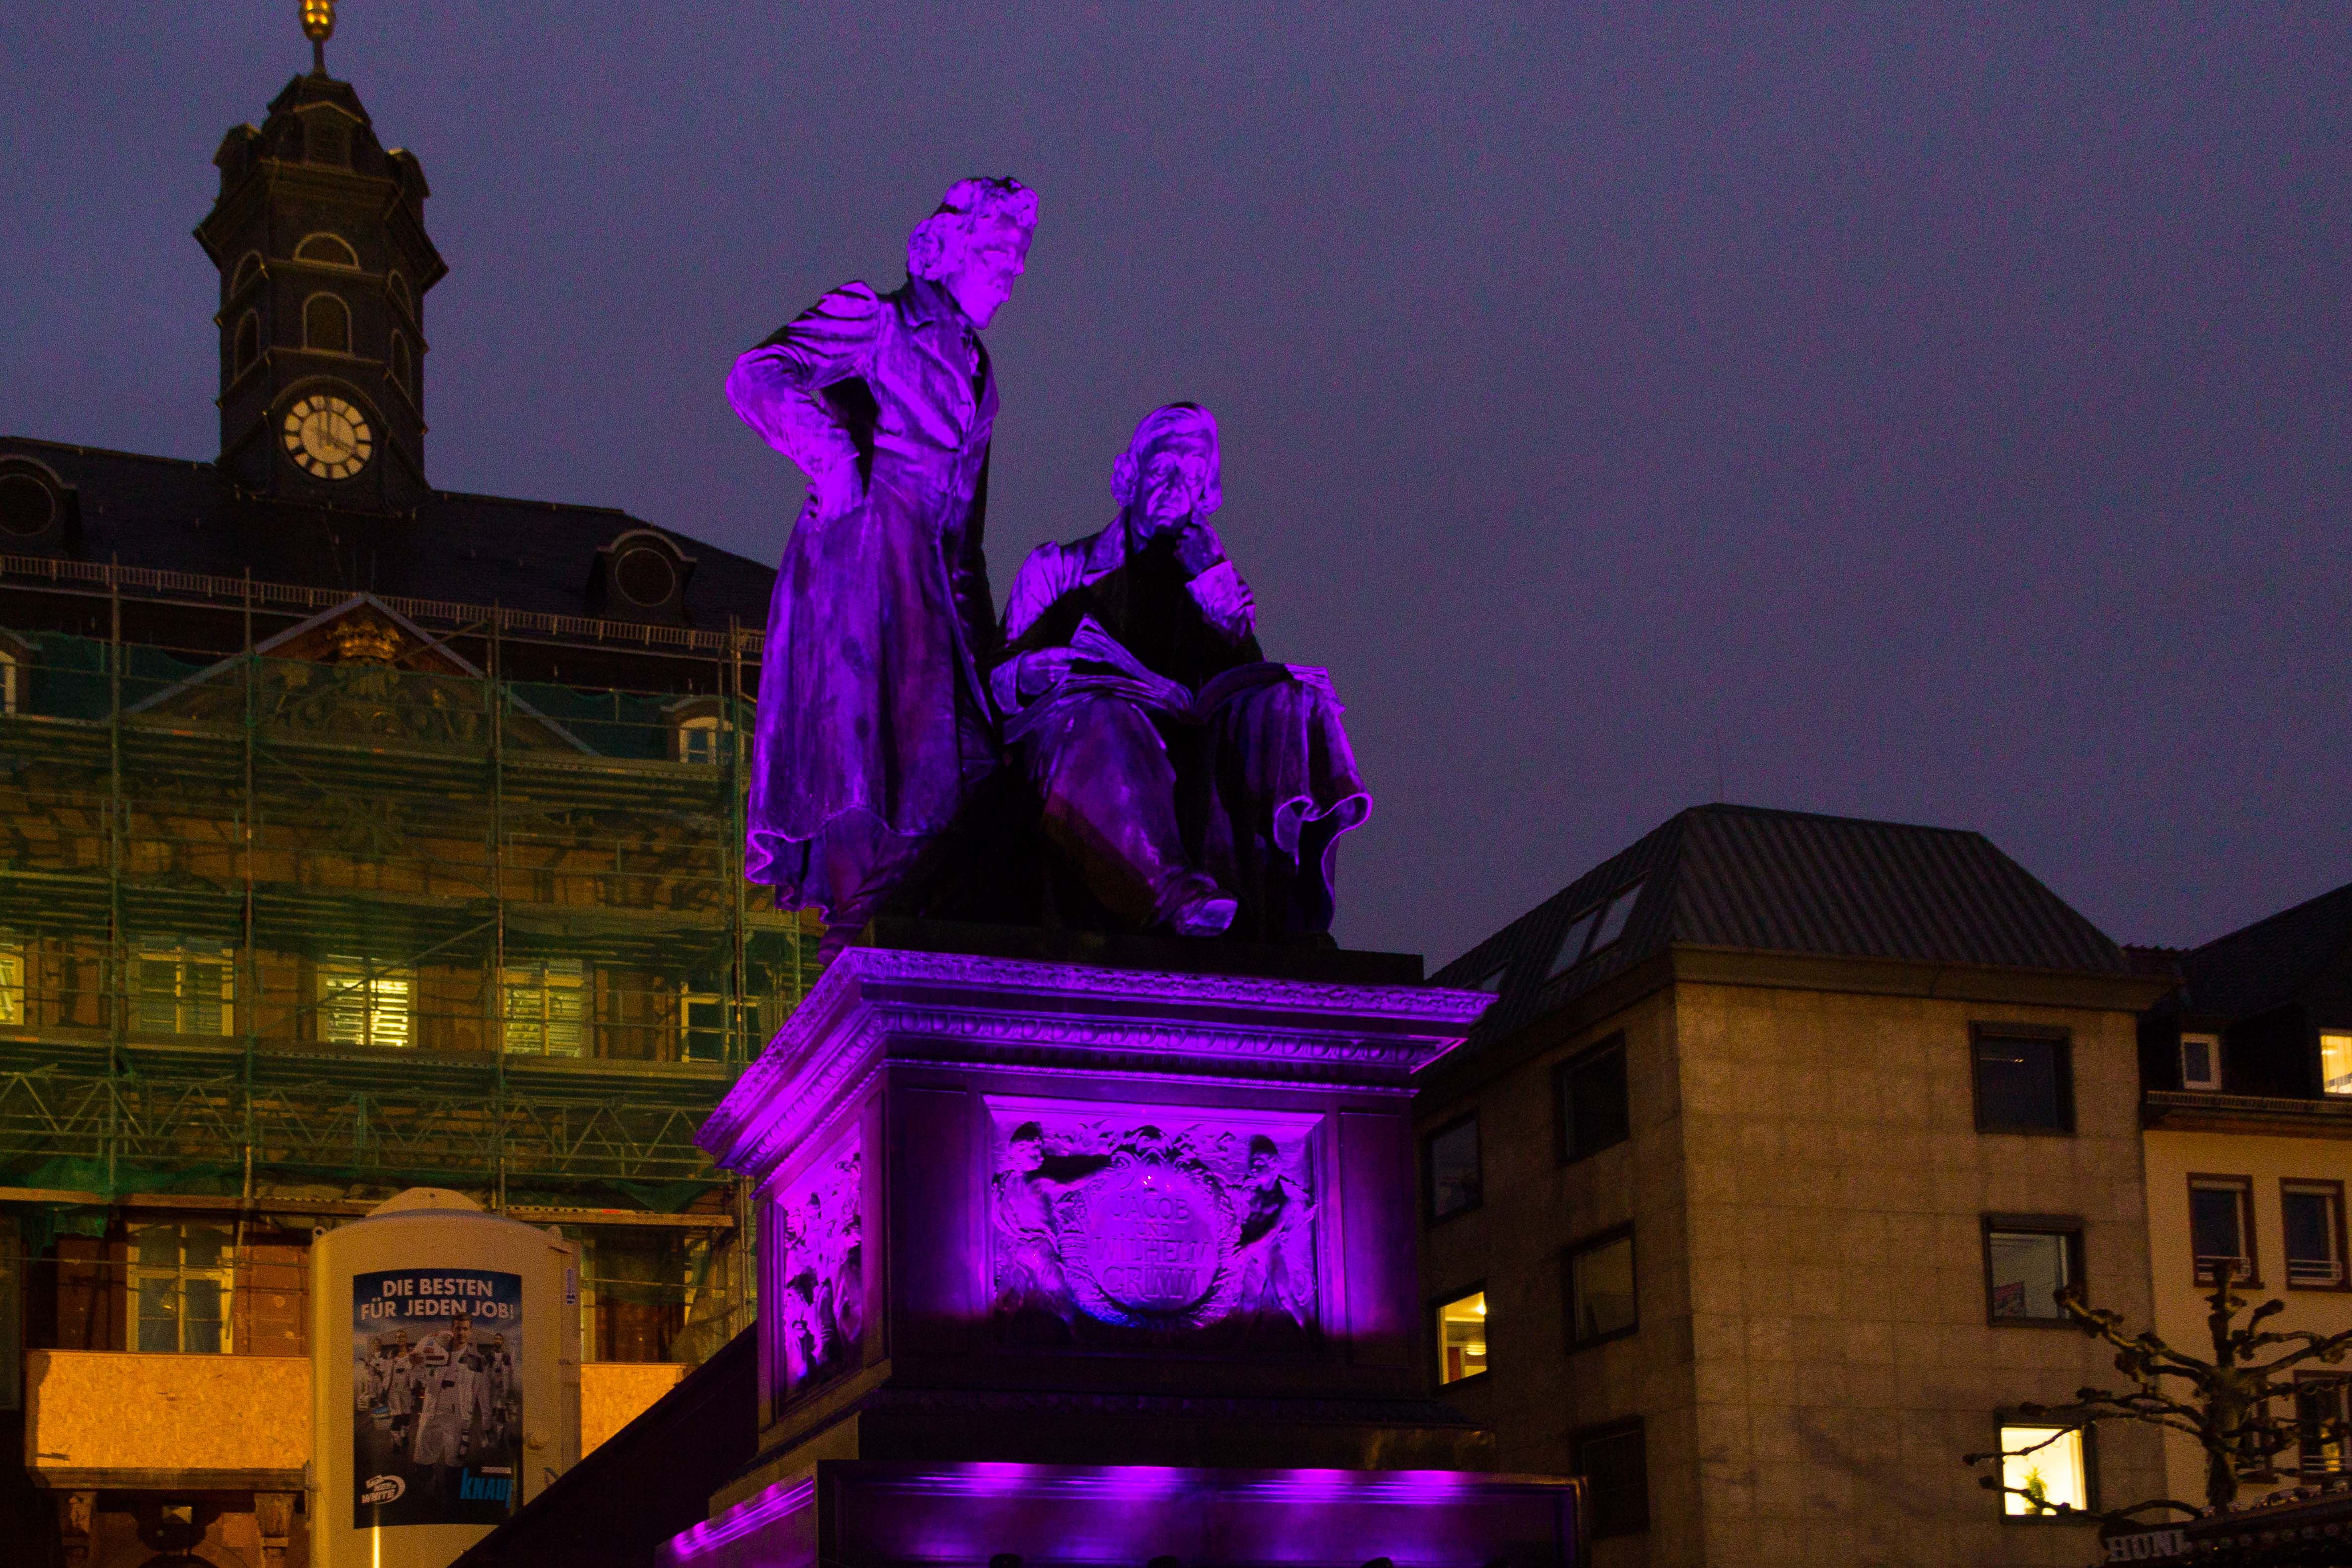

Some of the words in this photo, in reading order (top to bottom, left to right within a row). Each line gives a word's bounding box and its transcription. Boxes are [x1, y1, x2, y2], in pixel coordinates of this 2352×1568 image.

[1110, 1196, 1191, 1222] JACOB
[1134, 1222, 1171, 1237] UND
[382, 1279, 414, 1297] DIE
[419, 1278, 493, 1297] BESTEN
[1102, 1265, 1200, 1302] GRIMM
[361, 1297, 397, 1320] FÜR
[403, 1298, 468, 1317] JEDEN
[472, 1300, 515, 1320] JOB!
